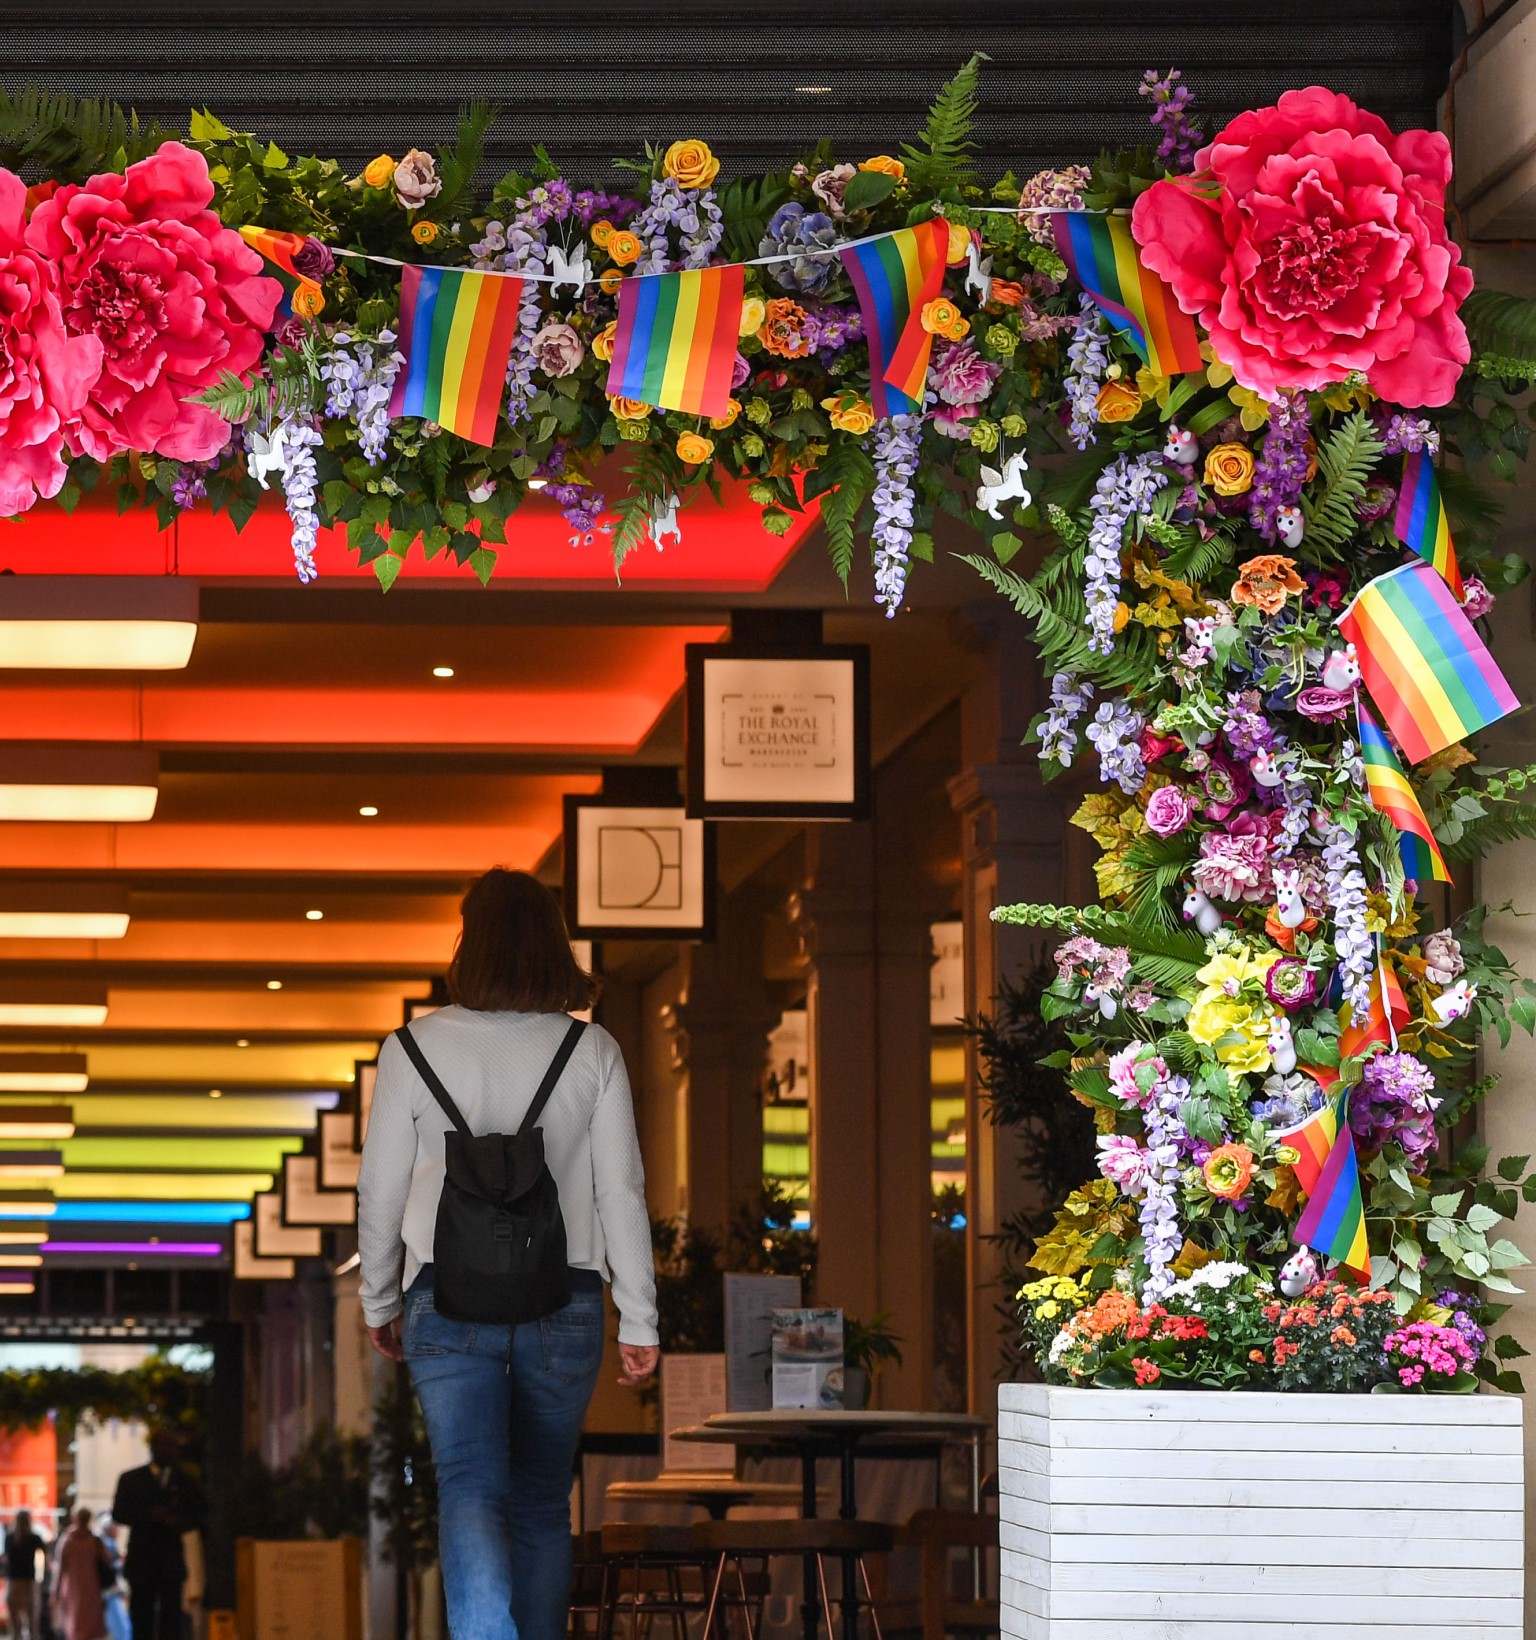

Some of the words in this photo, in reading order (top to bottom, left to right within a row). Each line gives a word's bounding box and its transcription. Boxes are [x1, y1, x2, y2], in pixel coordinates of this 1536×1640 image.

[739, 716, 764, 729] THE
[771, 716, 817, 729] ROYAL
[738, 732, 818, 745] EXCHANGE
